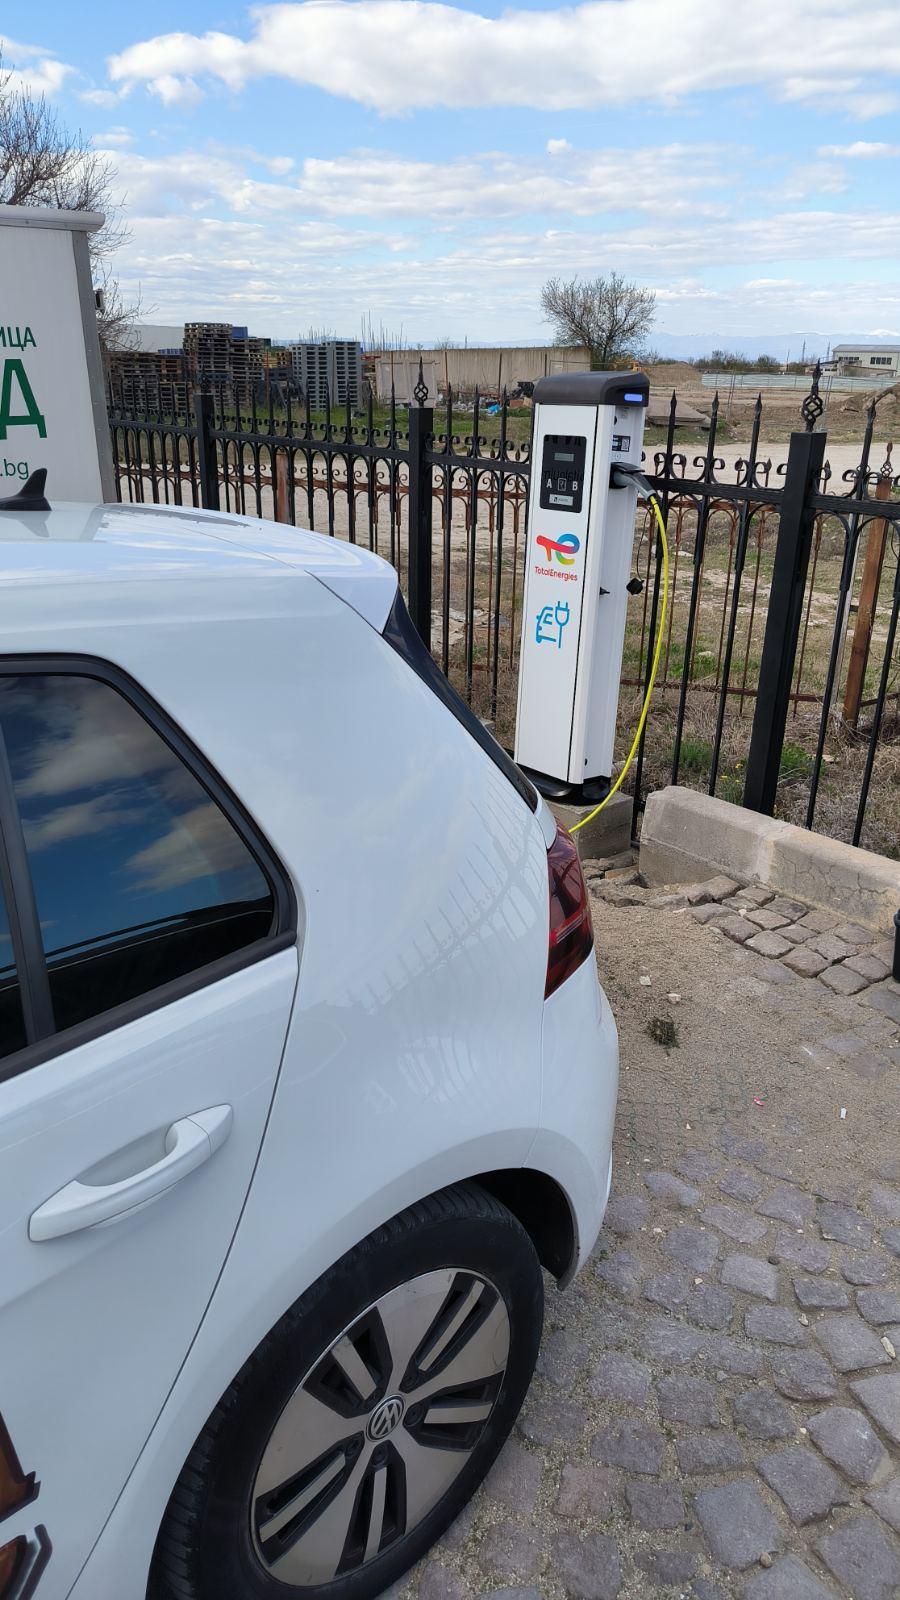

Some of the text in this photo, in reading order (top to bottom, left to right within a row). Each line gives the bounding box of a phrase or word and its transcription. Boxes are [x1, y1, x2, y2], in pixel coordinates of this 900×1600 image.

[546, 479, 578, 491] A B
[535, 566, 578, 581] TotalEnergies
